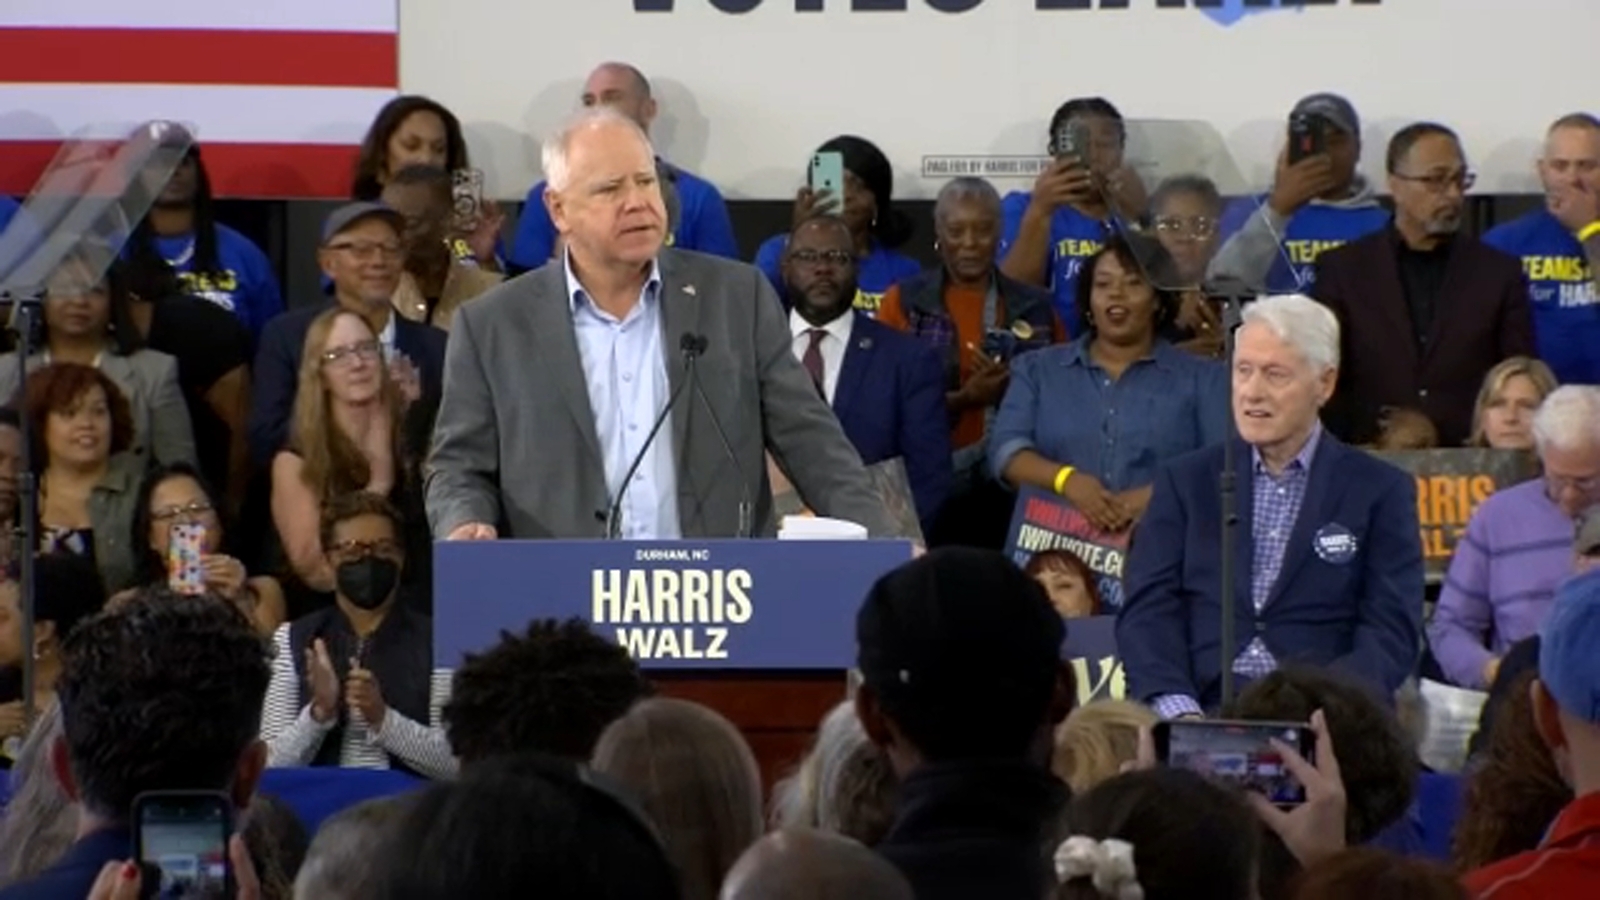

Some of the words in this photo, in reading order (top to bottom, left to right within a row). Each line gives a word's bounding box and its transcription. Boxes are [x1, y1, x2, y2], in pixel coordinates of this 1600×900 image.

[692, 550, 709, 560] NC
[592, 569, 753, 623] HARRIS
[616, 627, 728, 658] WALZ
